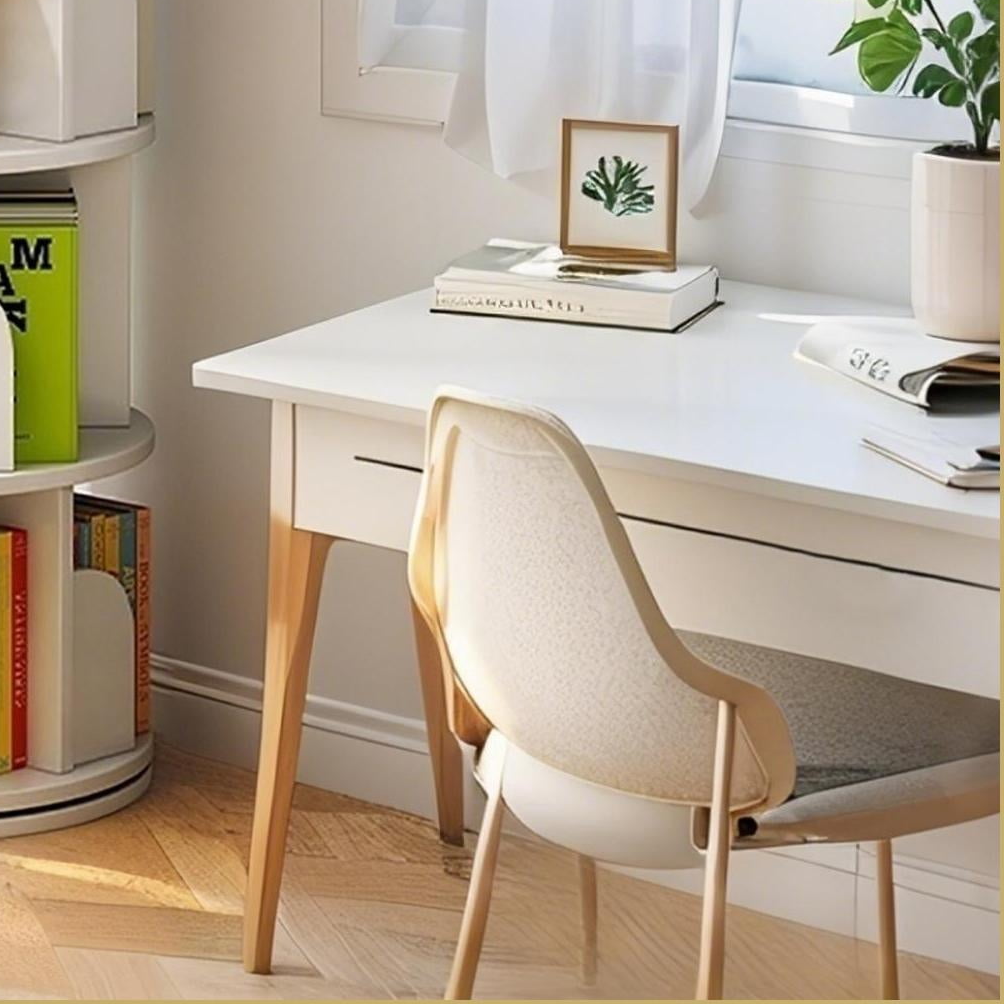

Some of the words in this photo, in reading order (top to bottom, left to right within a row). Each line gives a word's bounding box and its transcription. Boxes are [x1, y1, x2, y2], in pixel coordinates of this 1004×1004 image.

[11, 238, 52, 270] M
[139, 562, 148, 609] BOOK
[139, 625, 149, 702] SYMBOLS
